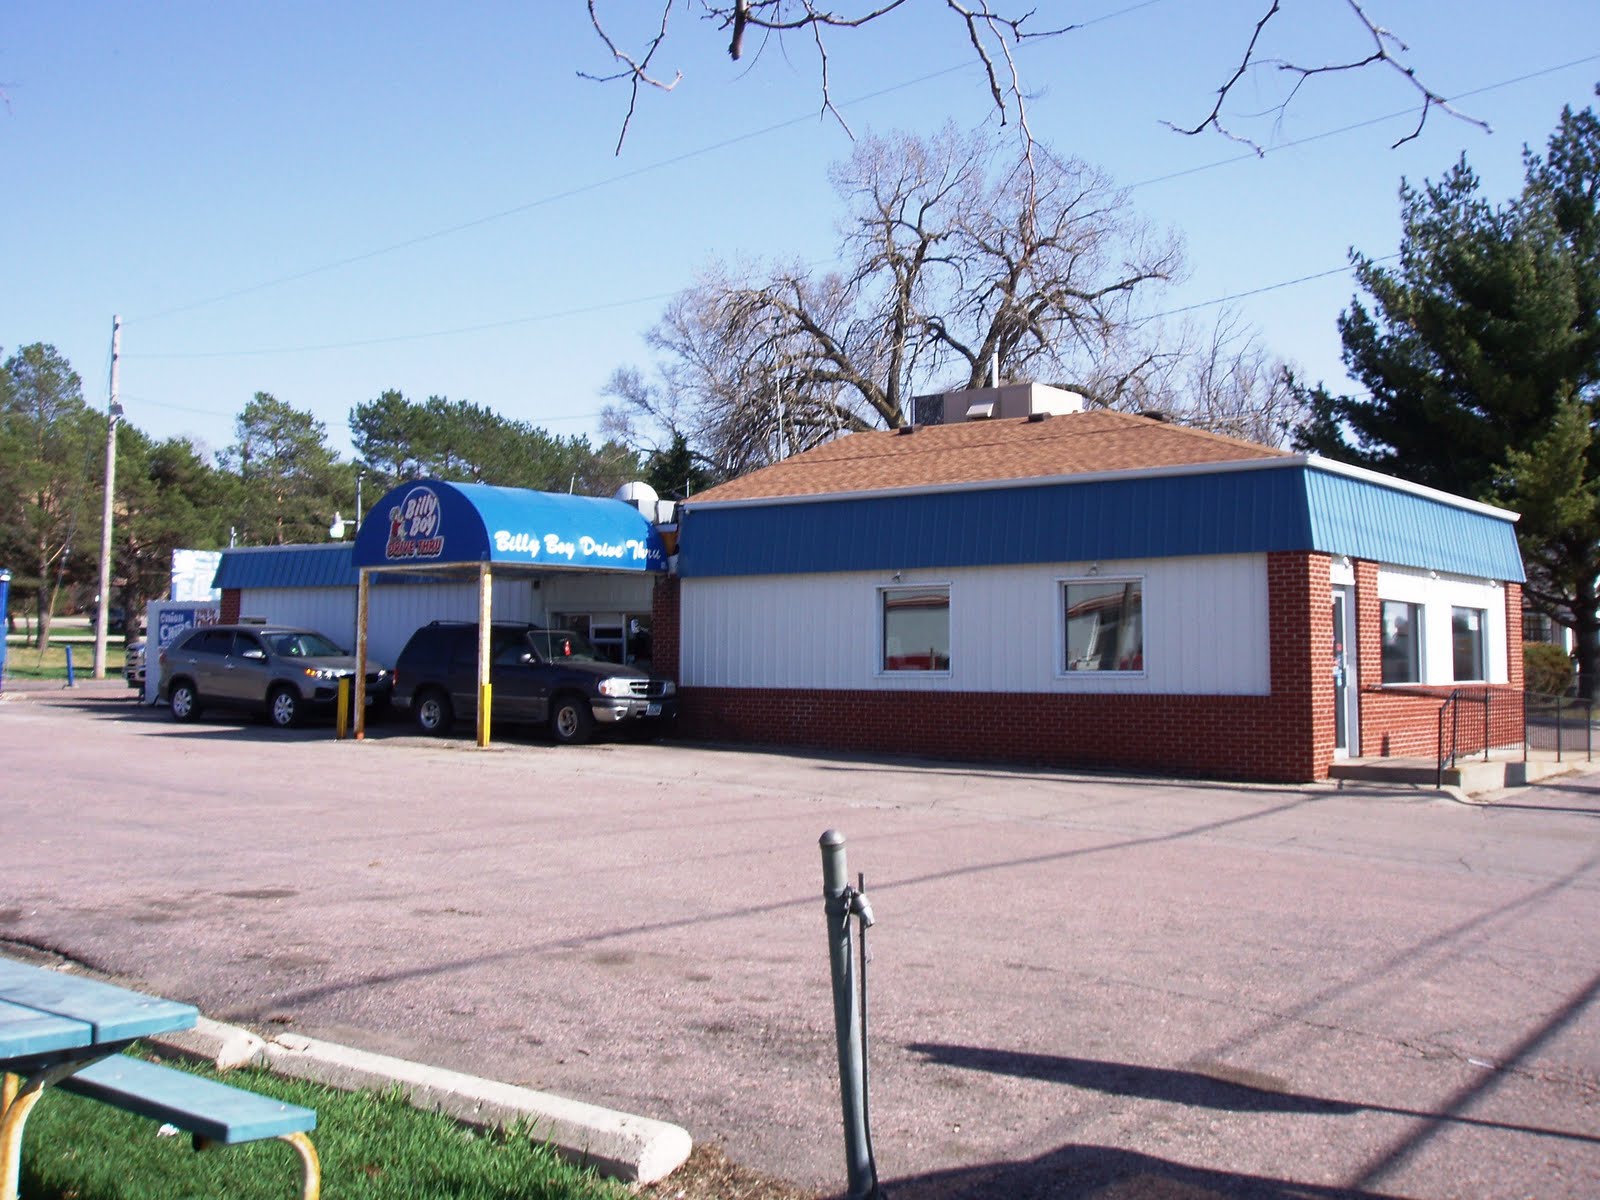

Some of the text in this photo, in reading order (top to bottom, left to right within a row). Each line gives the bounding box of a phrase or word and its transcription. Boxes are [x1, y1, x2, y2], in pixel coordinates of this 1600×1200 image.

[405, 494, 437, 520] Billy
[409, 514, 437, 537] Boy
[388, 539, 442, 556] DRIVE THRU
[494, 530, 662, 560] Billy Boy Drive Thru
